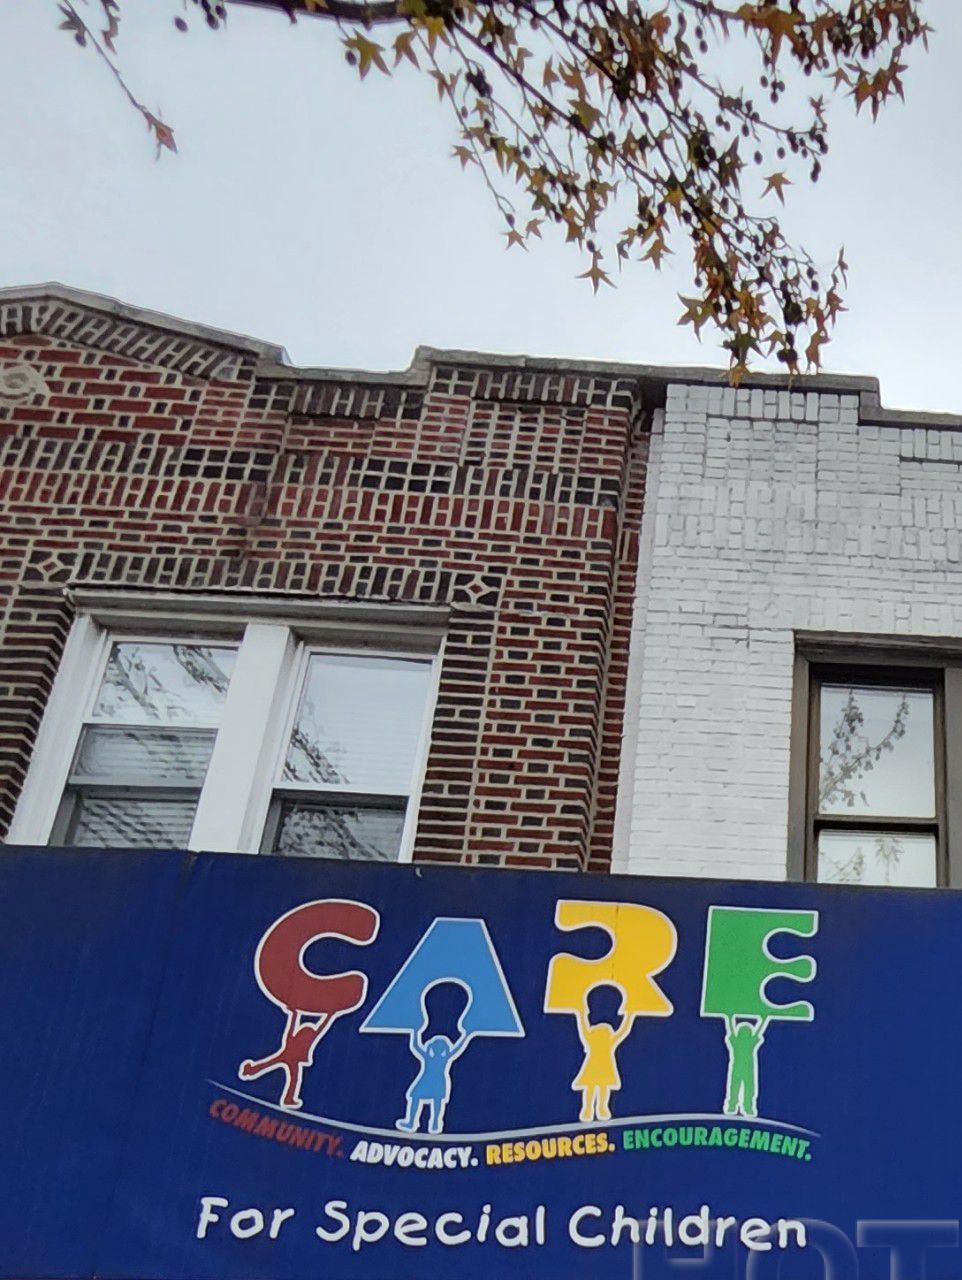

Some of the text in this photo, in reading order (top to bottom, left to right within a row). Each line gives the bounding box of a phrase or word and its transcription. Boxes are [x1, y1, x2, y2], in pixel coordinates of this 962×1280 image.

[253, 898, 820, 1038] CARE
[208, 1098, 812, 1169] COMMUNITY. ADVOCACY. RESOURCES. ENCOURAGEMENT.
[196, 1196, 807, 1252] For Special Children
